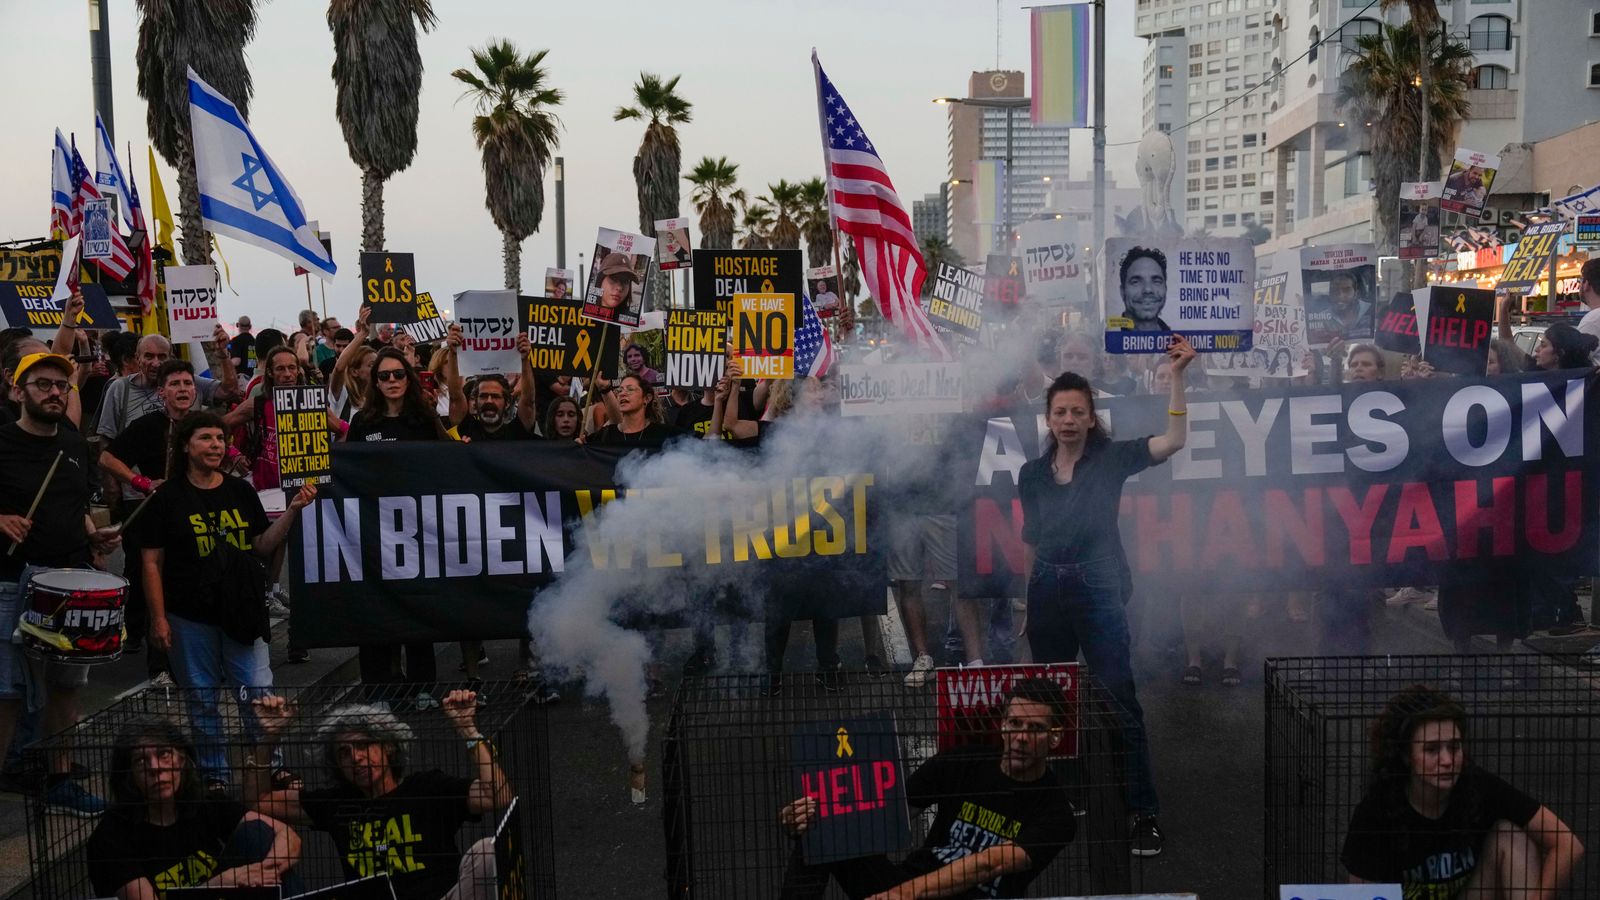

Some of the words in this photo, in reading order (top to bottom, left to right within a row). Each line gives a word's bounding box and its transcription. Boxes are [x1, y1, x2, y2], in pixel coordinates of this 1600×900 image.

[1525, 226, 1539, 236] MR.
[1540, 222, 1566, 234] BIDEN
[1026, 241, 1077, 265] עסקה
[1513, 233, 1556, 258] SEAL
[714, 257, 779, 276] HOSTAGE
[1179, 252, 1192, 266] HE
[1195, 252, 1214, 266] HAS
[1217, 252, 1230, 265] NO
[1501, 257, 1543, 282] DEAL
[1028, 264, 1080, 283] עכשיו
[1179, 270, 1204, 284] TIME
[1205, 270, 1217, 283] TO
[15, 285, 54, 297] HOST
[171, 287, 217, 307] עסקה
[367, 278, 413, 303] S.O.S
[715, 278, 749, 297] DEAL
[933, 278, 955, 302] NO
[956, 286, 984, 313] ONE
[1179, 288, 1208, 302] BRING
[1254, 286, 1282, 305] EAL
[1564, 278, 1581, 294] PIZZ
[20, 298, 62, 310] DEAL
[416, 303, 439, 320] ME
[528, 303, 597, 327] HOSTAG
[716, 301, 734, 321] NO
[741, 298, 758, 311] WE
[760, 298, 785, 311] HAVE
[929, 297, 981, 331] BEHIND!
[1179, 306, 1208, 319] HOME
[1210, 305, 1240, 319] ALIVE!
[26, 311, 64, 325] NOW
[459, 316, 515, 338] עסקה
[669, 311, 690, 326] ALL
[696, 312, 726, 326] THEM
[1253, 320, 1300, 334] OSING
[1379, 310, 1419, 336] HEL
[403, 317, 448, 343] NOW!
[527, 325, 567, 347] DEAL
[668, 327, 726, 353] HOME
[739, 311, 788, 355] NO
[1428, 316, 1489, 350] HELP
[461, 337, 515, 352] עכשיו
[1122, 336, 1154, 350] BRING
[1214, 335, 1240, 349] NOW!
[528, 348, 566, 370] NOW
[741, 356, 785, 375] TIME!
[666, 353, 725, 388] NOW!
[840, 371, 896, 405] Hostage
[275, 389, 298, 411] HEY
[300, 388, 325, 410] JOE!
[277, 413, 296, 433] MR.
[298, 411, 327, 432] BIDEN
[1172, 390, 1410, 482] EYES
[1442, 378, 1585, 467] ON
[279, 432, 311, 457] HELP
[313, 431, 329, 453] US
[281, 457, 304, 474] SAVE
[304, 454, 330, 473] THEM!
[302, 496, 363, 584] IN
[380, 490, 564, 581] BIDEN
[575, 487, 683, 570] WE
[697, 472, 875, 565] TRUST
[975, 470, 1583, 576] NHANYAHU
[196, 529, 253, 557] DAL
[802, 760, 896, 819] HELP
